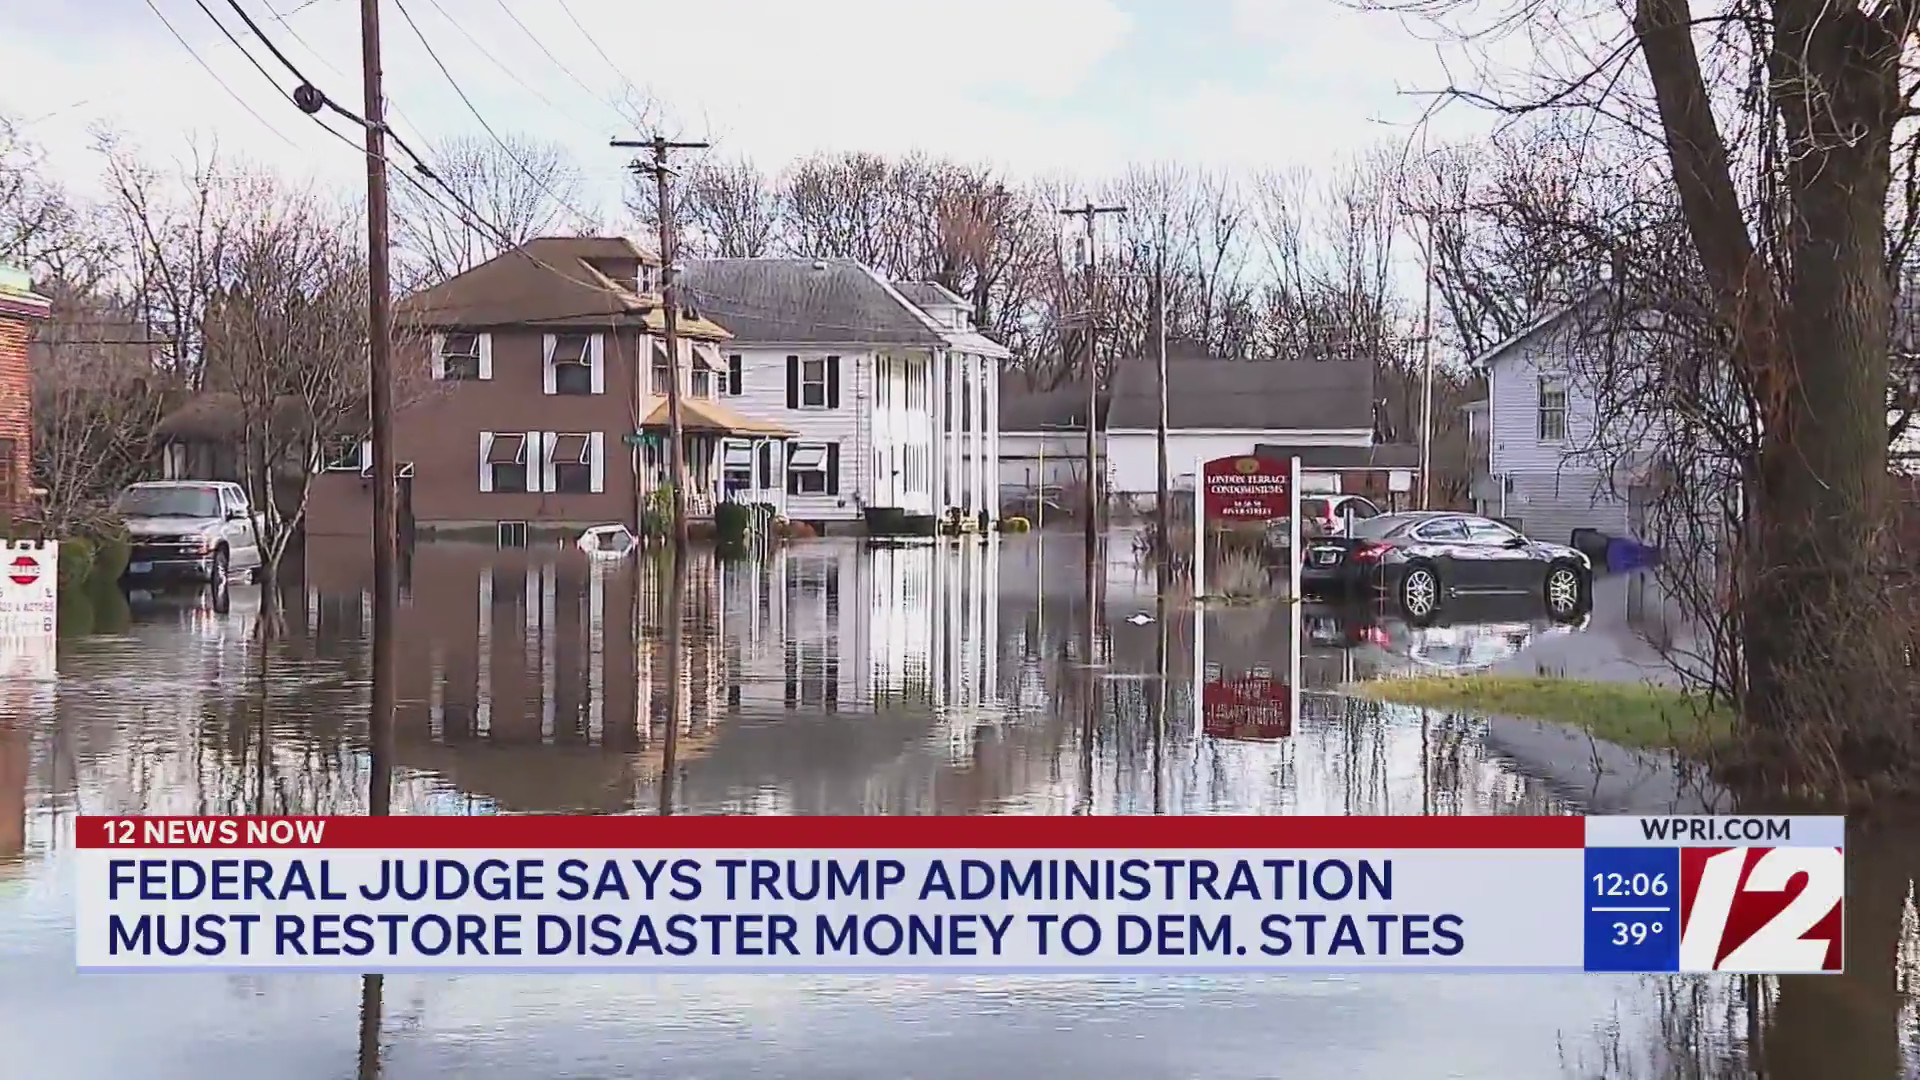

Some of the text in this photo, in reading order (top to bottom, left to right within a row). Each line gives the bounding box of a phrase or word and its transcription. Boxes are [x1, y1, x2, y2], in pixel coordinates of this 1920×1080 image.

[1207, 475, 1286, 484] LONDON TERRACE
[1211, 485, 1284, 494] CONDOMINIUMS
[1246, 507, 1272, 515] STREET
